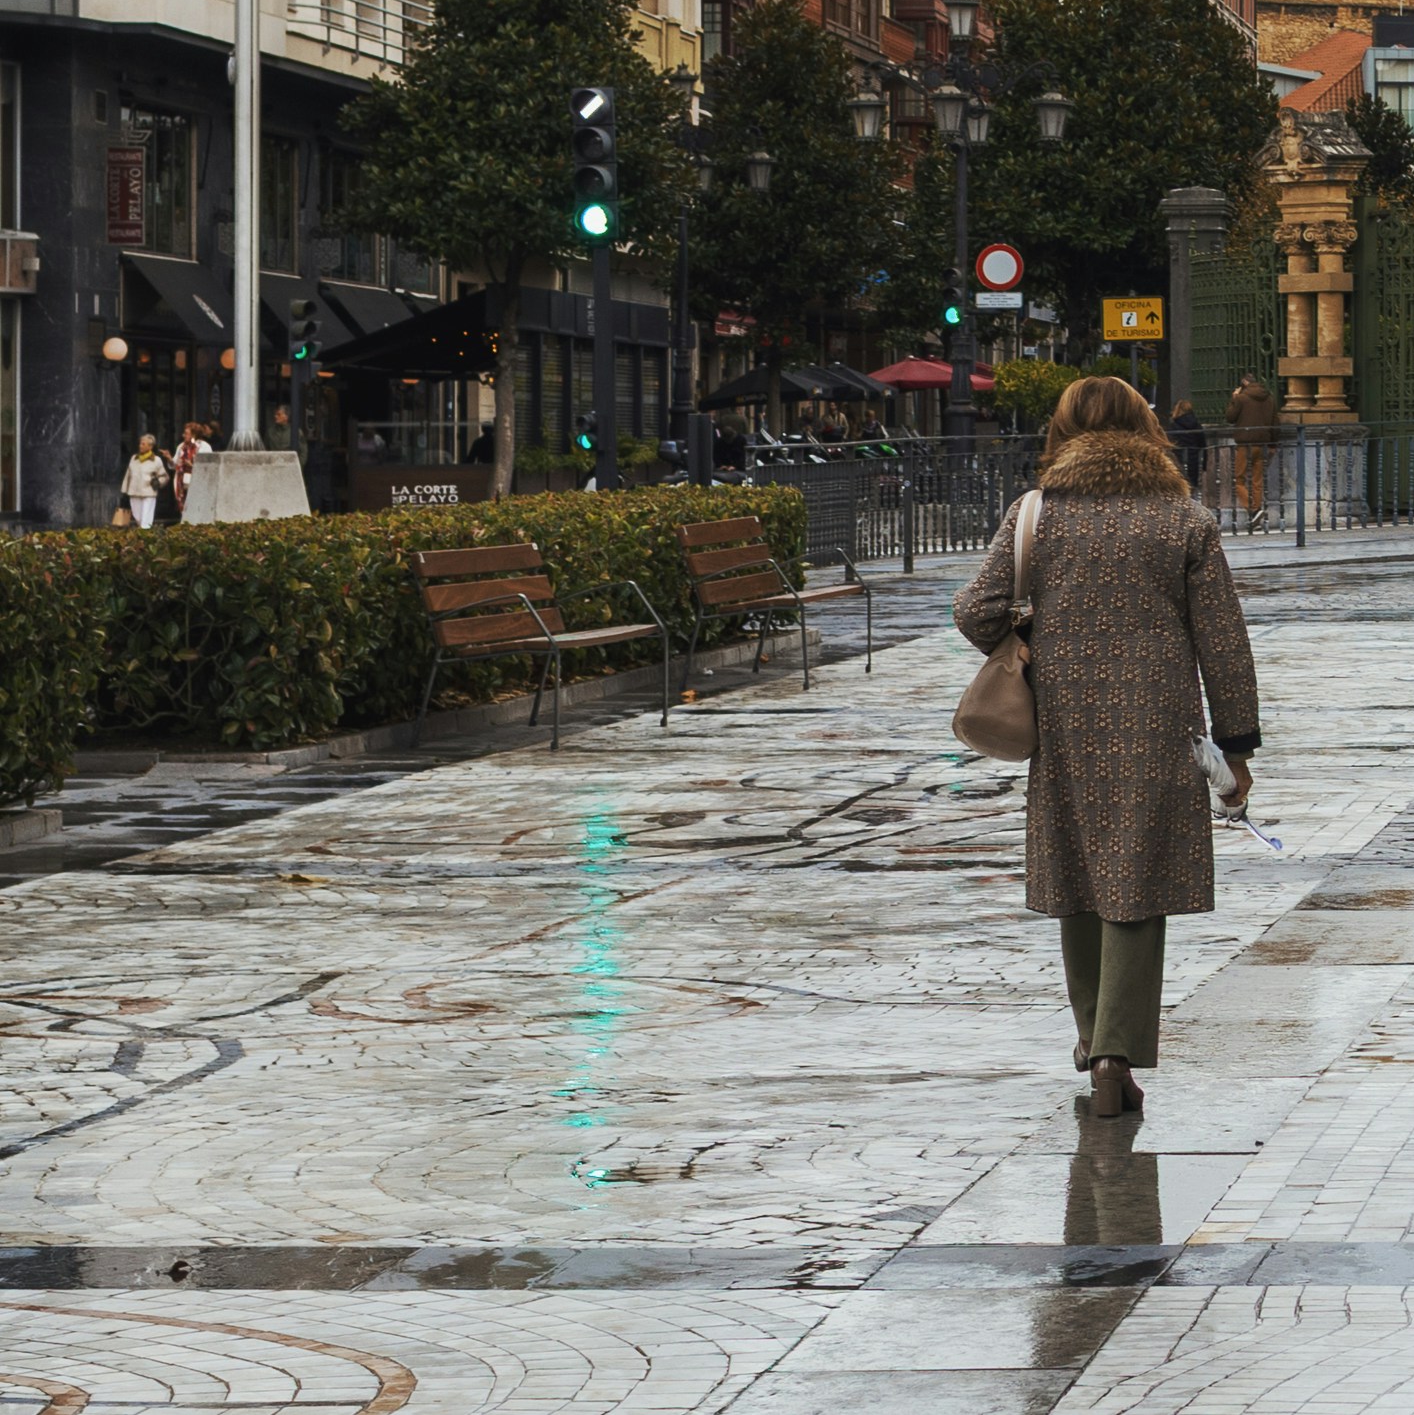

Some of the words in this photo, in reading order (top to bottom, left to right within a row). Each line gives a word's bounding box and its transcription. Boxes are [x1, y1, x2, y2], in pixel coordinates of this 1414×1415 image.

[129, 168, 141, 220] PELAYO
[1115, 301, 1151, 309] OFICINA
[1106, 329, 1119, 337] DE
[1121, 328, 1161, 337] TURISMO
[392, 486, 410, 495] LA
[414, 485, 458, 494] CORTE
[399, 495, 459, 503] PELAYO
